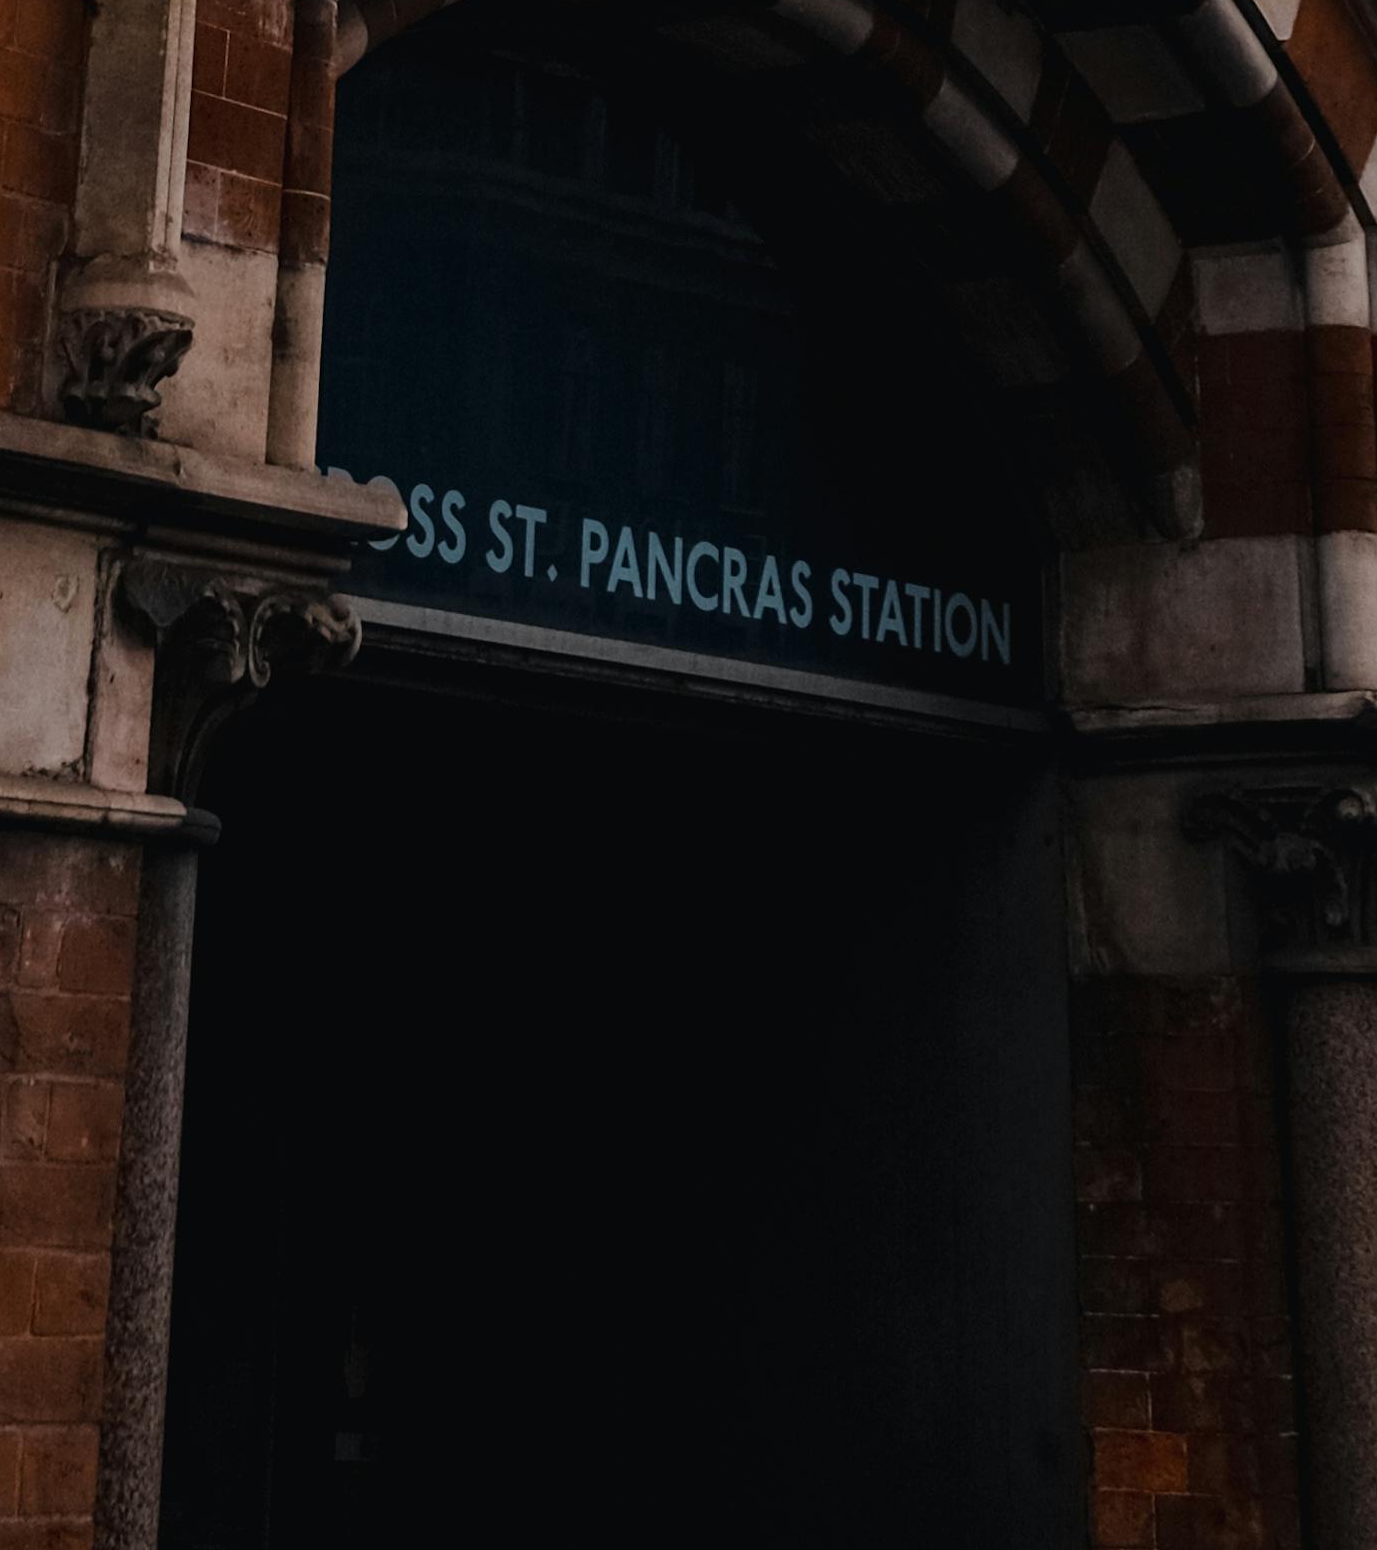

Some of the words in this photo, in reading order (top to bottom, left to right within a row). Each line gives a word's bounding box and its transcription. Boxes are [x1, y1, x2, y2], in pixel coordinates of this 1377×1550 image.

[484, 499, 560, 583] ST.
[579, 517, 814, 630] PANCRAS
[828, 567, 1012, 665] STATION
